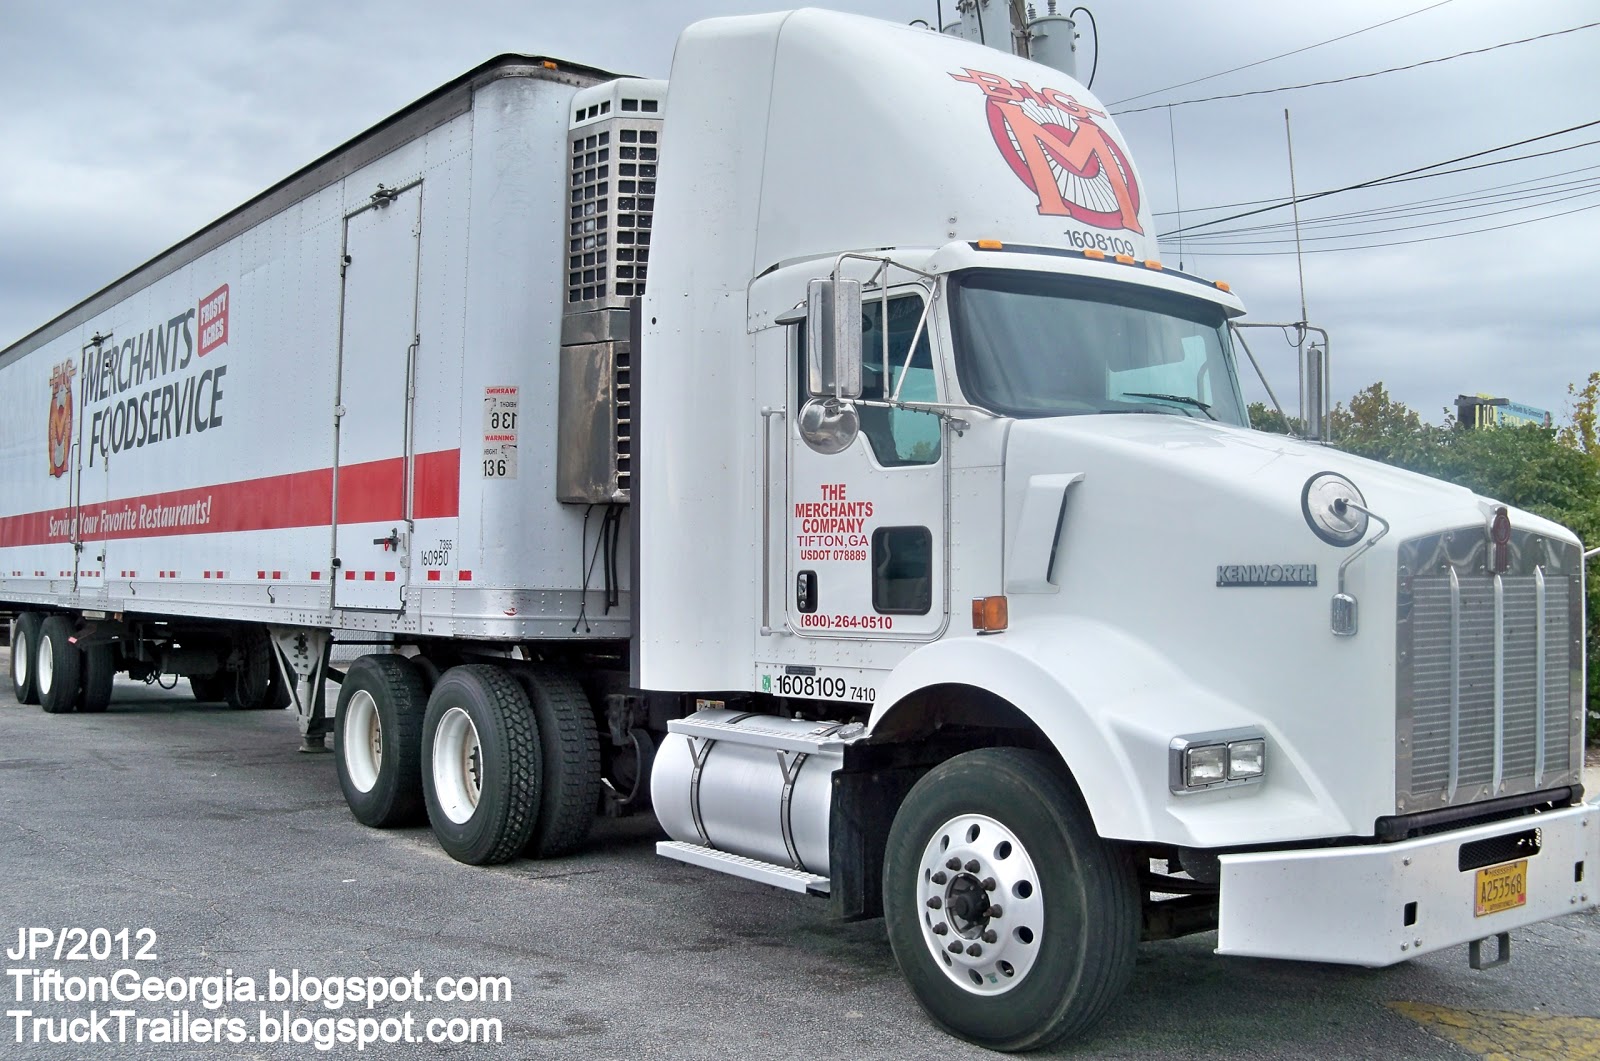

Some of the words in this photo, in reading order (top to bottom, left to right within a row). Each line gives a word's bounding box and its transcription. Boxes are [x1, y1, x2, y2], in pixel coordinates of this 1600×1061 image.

[1064, 229, 1135, 257] 1608109
[200, 291, 227, 326] FROSTY
[202, 321, 224, 349] ACRES
[84, 308, 195, 407] MERCHANTS
[89, 365, 227, 468] FOODSERVICE
[821, 484, 847, 500] THE
[79, 512, 98, 535] Your
[100, 504, 137, 532] Favorite
[139, 495, 212, 529] Restaurants!
[795, 501, 873, 518] MERCHANTS
[802, 518, 864, 534] COMPANY
[439, 539, 452, 550] 7355
[800, 550, 831, 561] USDOT
[833, 550, 867, 561] 078889
[421, 550, 449, 566] 160950
[1216, 564, 1317, 583] KENWORTH
[800, 614, 893, 629] (800)-264-0510
[776, 674, 846, 698] 1608109
[850, 686, 876, 702] 7410
[1481, 874, 1522, 903] A253568
